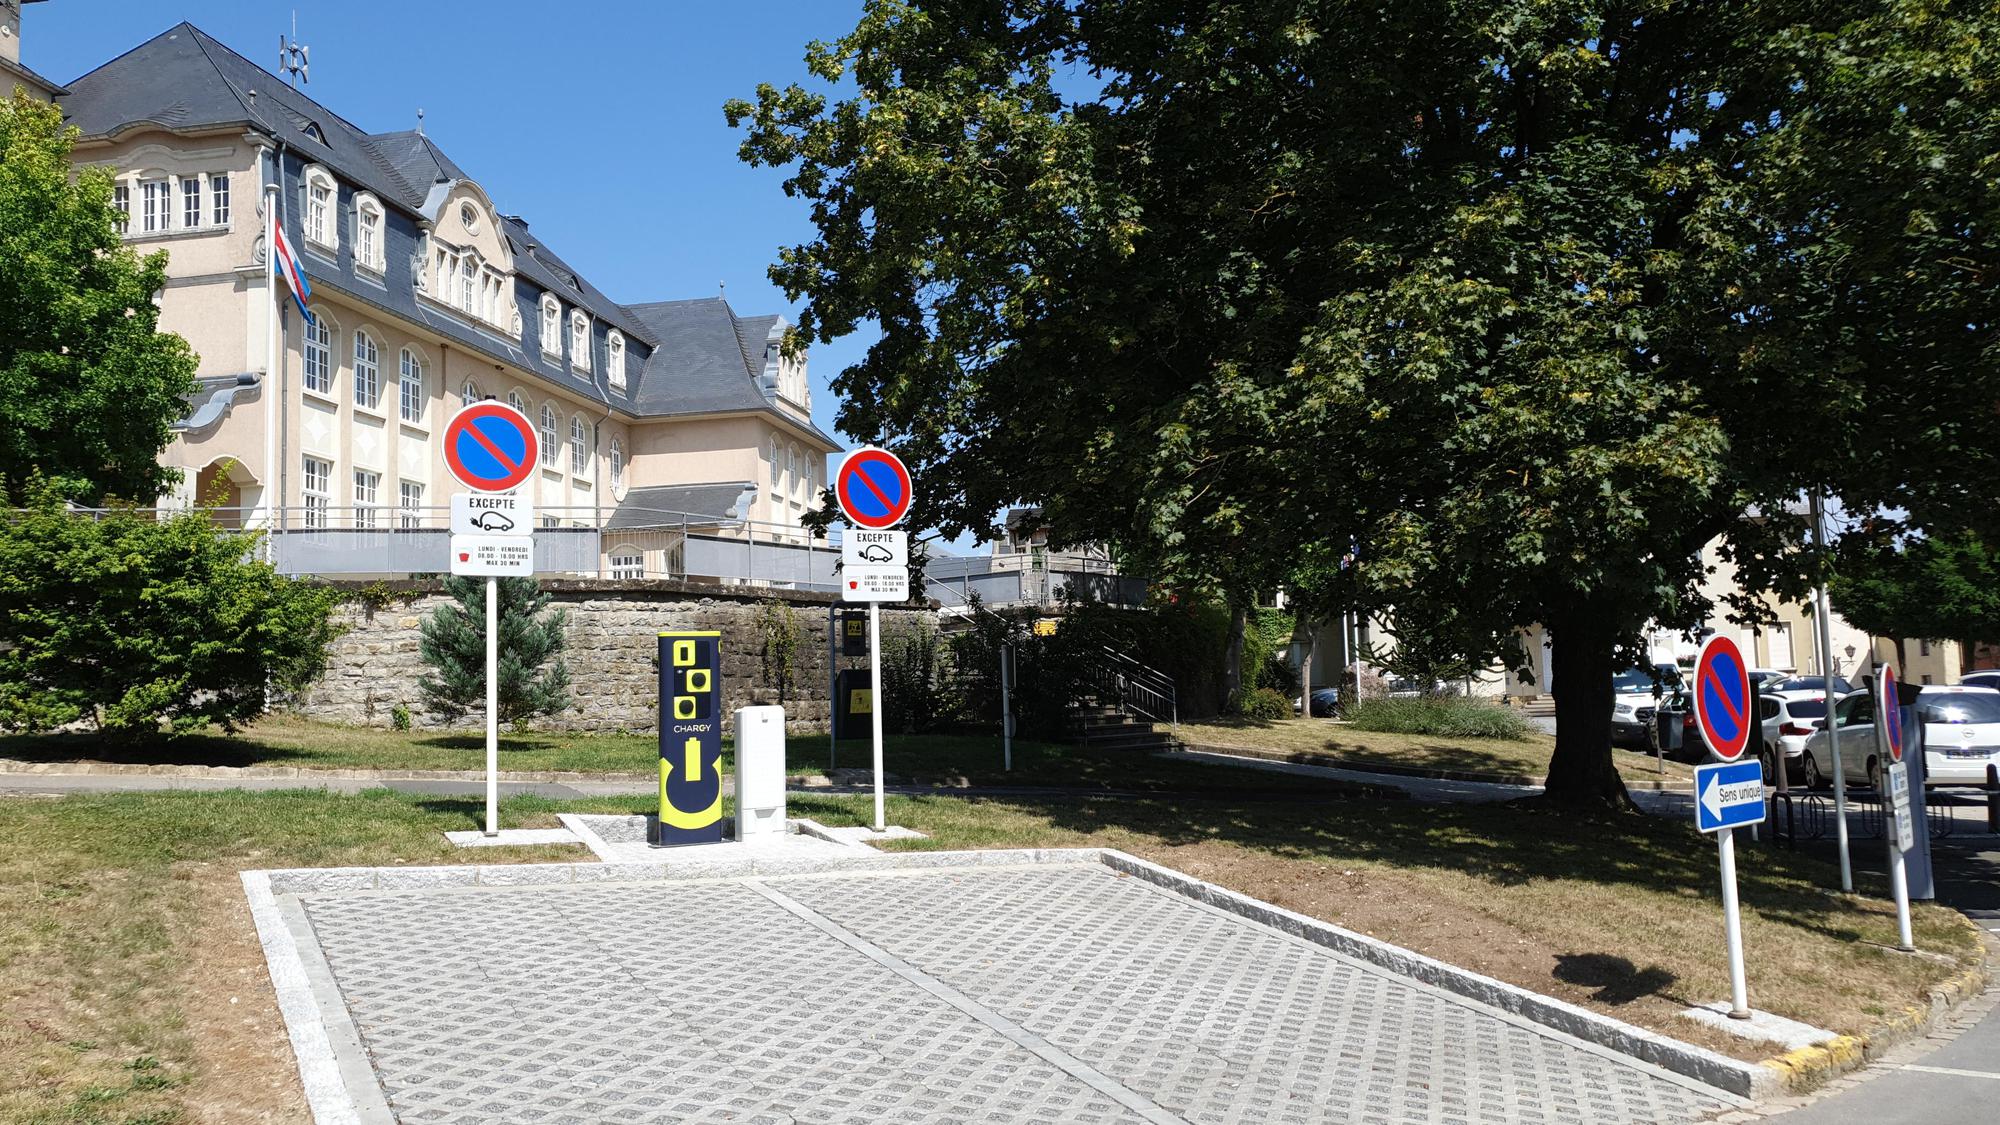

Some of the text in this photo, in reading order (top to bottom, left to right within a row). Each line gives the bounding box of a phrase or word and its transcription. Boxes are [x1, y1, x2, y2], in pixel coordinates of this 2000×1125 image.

[469, 498, 515, 509] EXCEPTE
[857, 533, 893, 542] EXCEPTE
[673, 724, 712, 733] CHARGY
[1720, 785, 1760, 802] Sens unique
